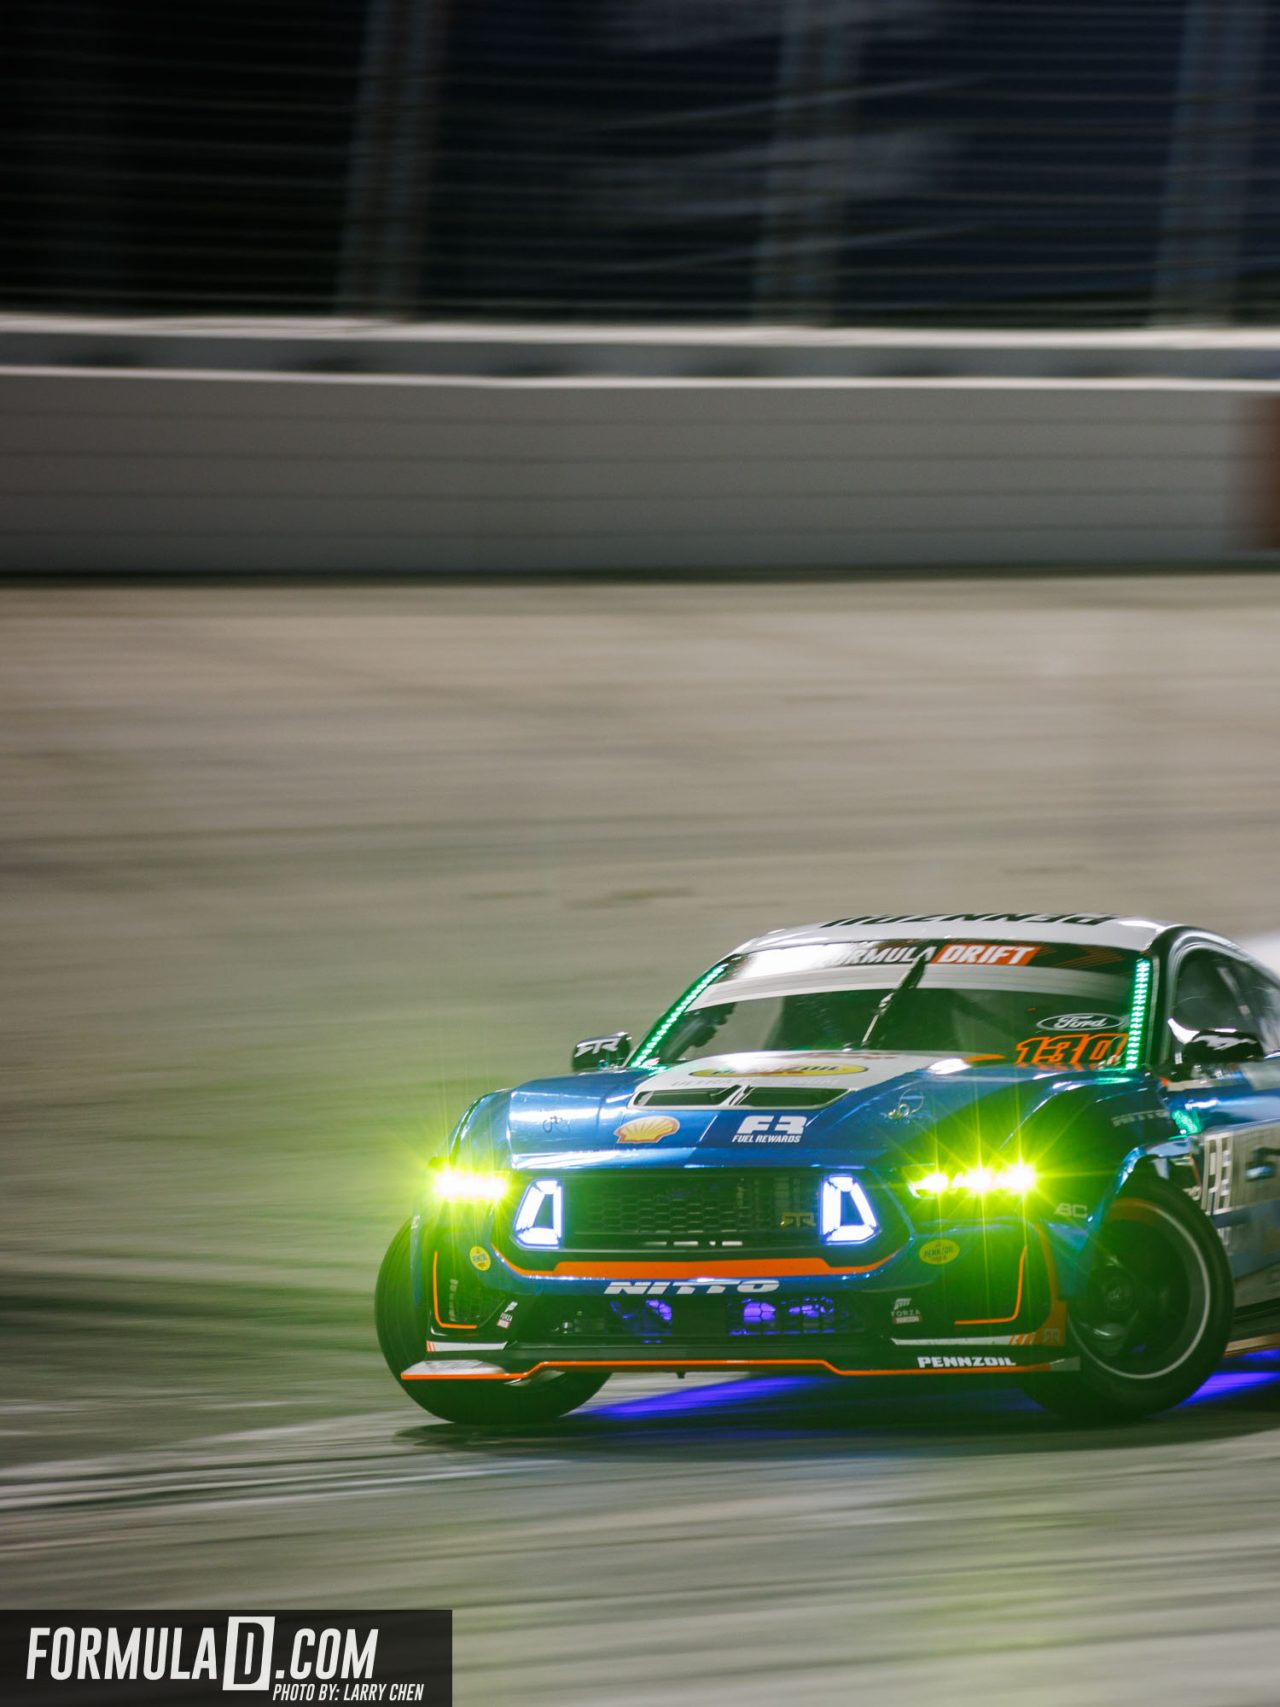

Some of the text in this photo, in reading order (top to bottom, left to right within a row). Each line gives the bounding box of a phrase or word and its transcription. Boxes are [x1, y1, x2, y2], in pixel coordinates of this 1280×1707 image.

[936, 944, 1035, 965] DRIFT
[1054, 1014, 1108, 1029] Ford
[731, 1134, 802, 1143] FUEL REWARDS
[603, 1279, 780, 1295] NITTO
[917, 1356, 1017, 1369] PENNZOIL
